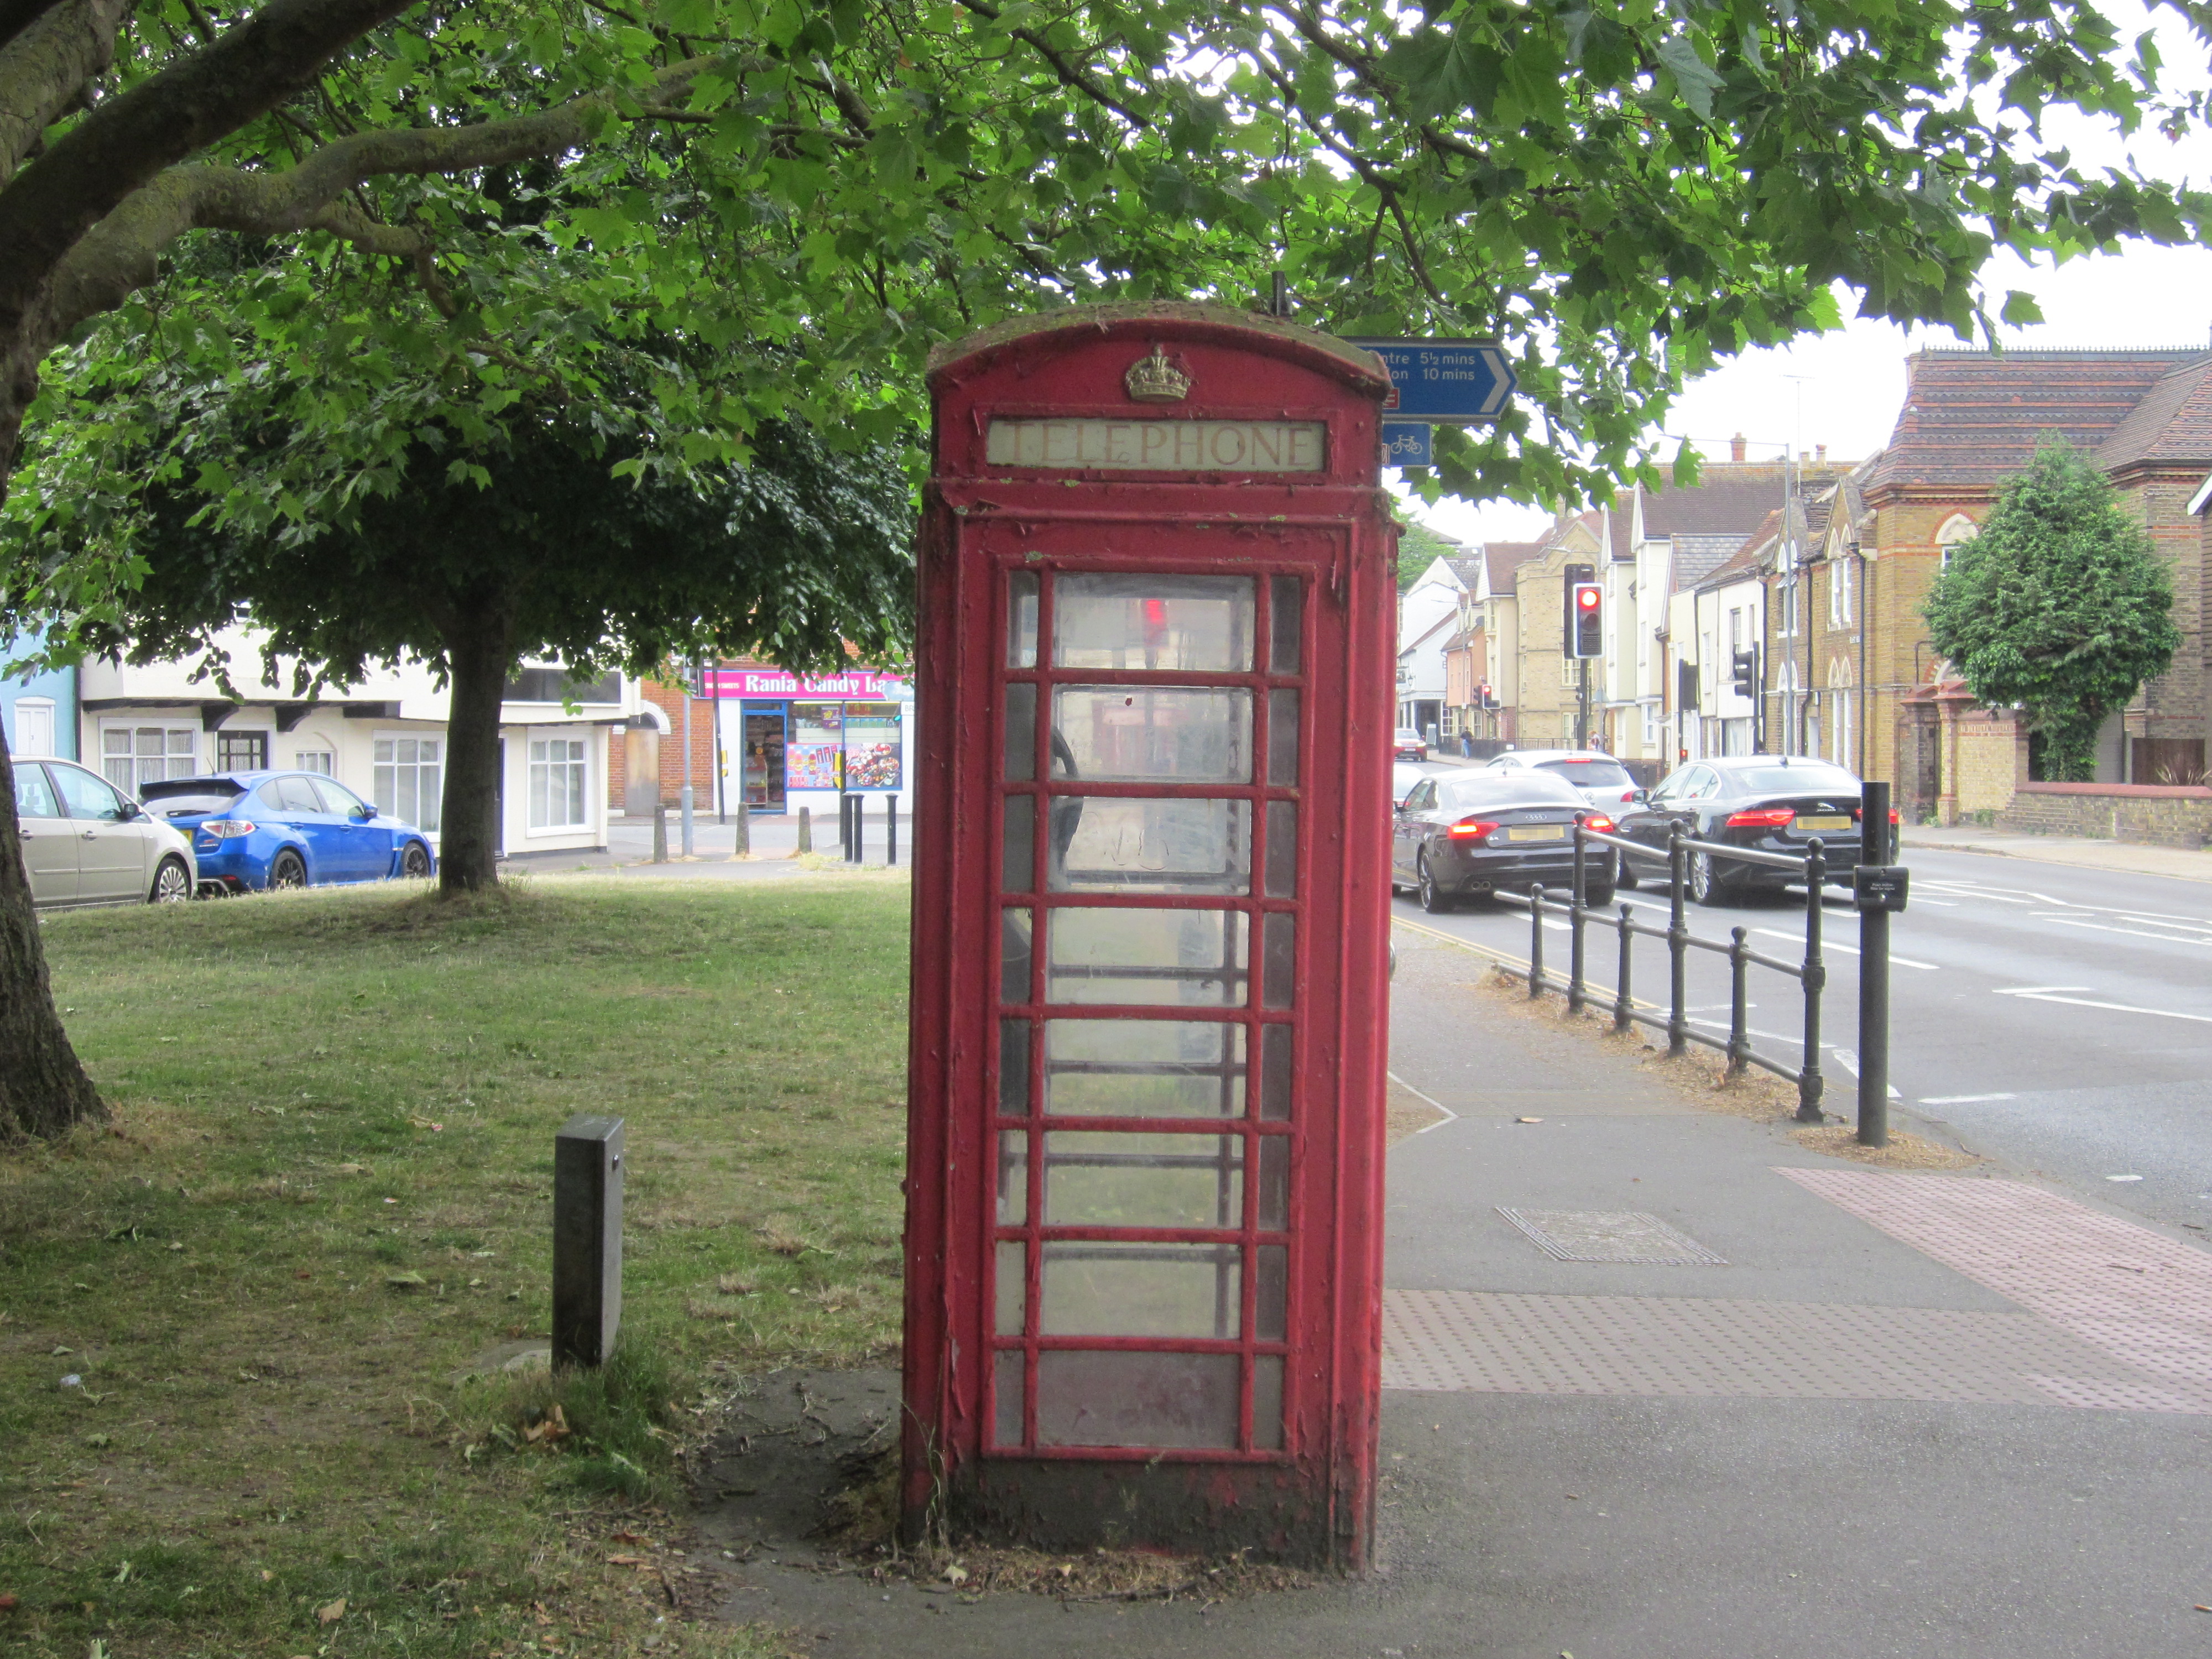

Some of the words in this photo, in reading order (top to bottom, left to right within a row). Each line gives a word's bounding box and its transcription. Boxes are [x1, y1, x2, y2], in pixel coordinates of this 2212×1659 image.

[1383, 352, 1410, 364] ntre
[1443, 353, 1475, 365] mins
[1391, 370, 1408, 380] on
[1423, 368, 1439, 380] 10
[1443, 368, 1475, 380] mins
[1003, 421, 1313, 467] TELEPHONE
[745, 675, 797, 692] Rania
[804, 675, 860, 696] Candy
